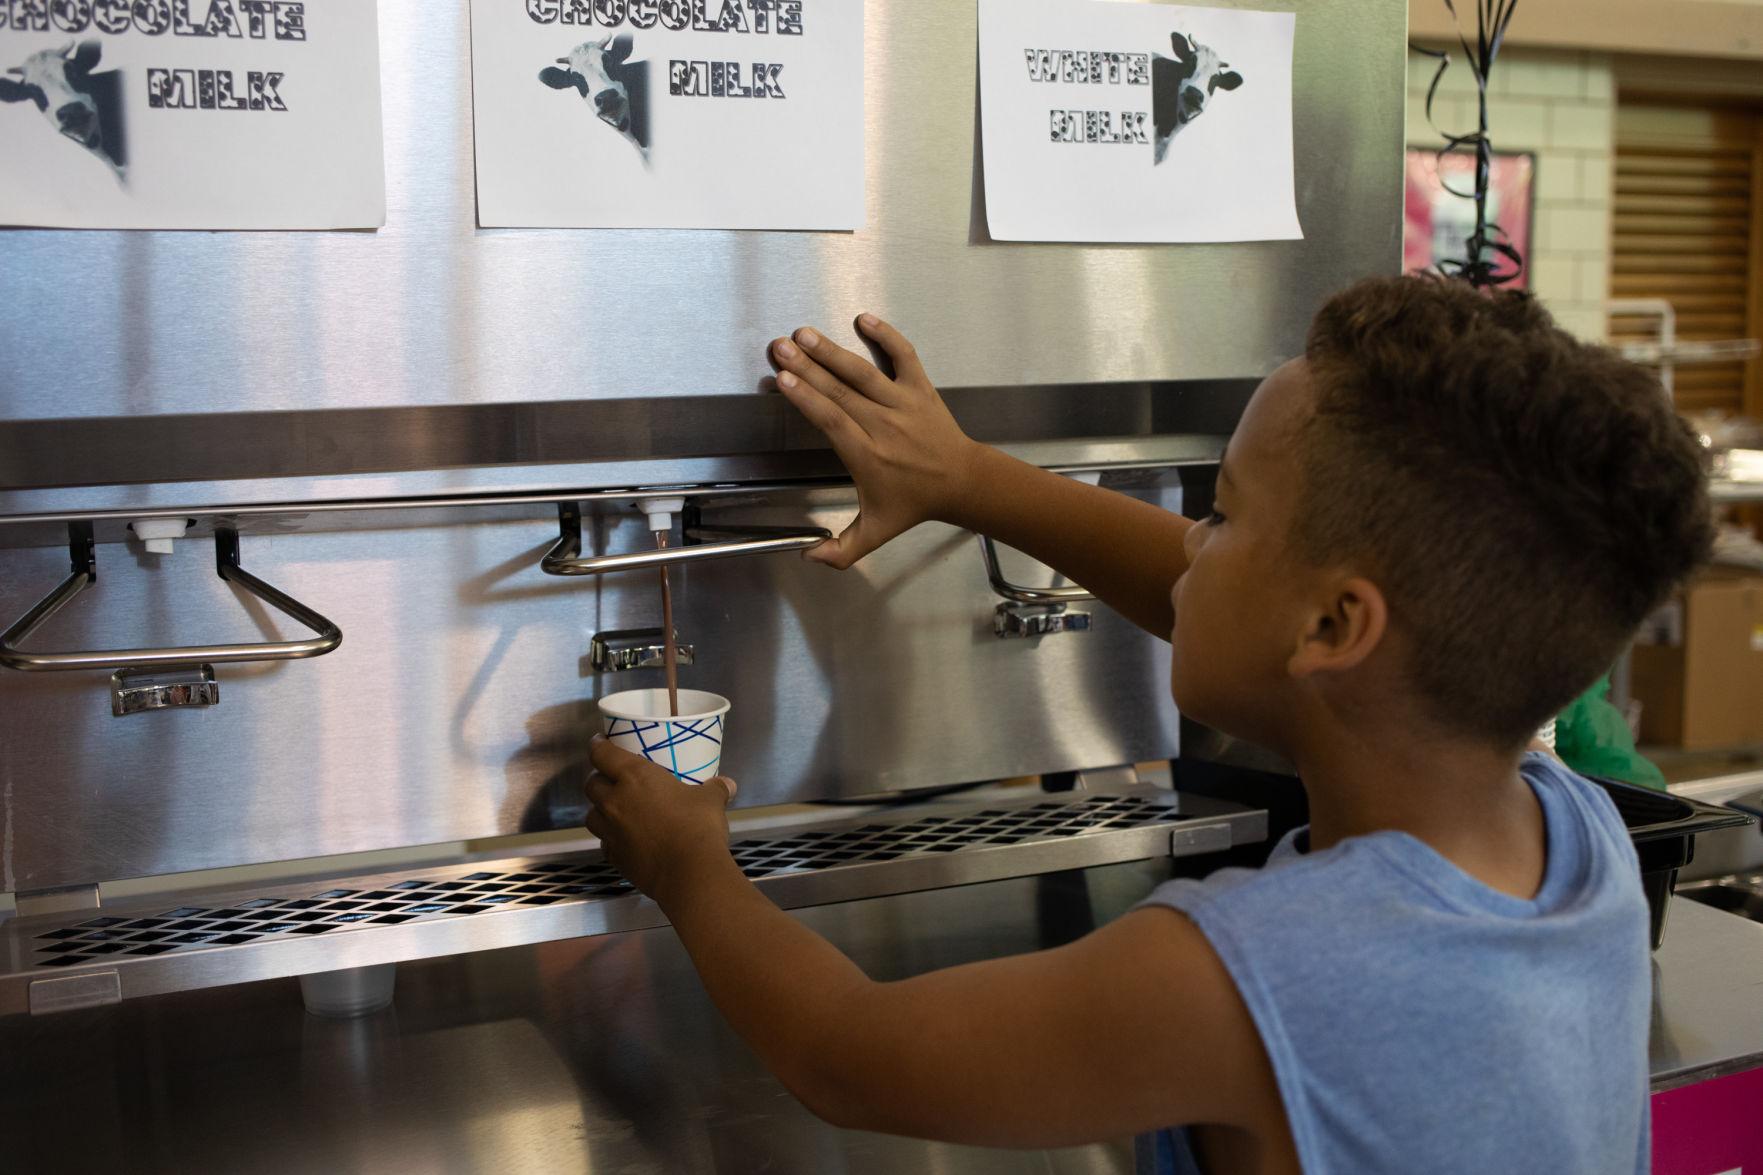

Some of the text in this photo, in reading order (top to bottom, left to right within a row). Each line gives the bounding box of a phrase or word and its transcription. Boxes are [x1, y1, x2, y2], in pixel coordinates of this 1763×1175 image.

[0, 0, 306, 41] HOCOLATE
[526, 0, 803, 36] CHOCOLATE
[670, 60, 785, 98] MILK
[1024, 49, 1149, 85] WHITE
[147, 68, 288, 111] MILK
[1050, 110, 1149, 144] MILK
